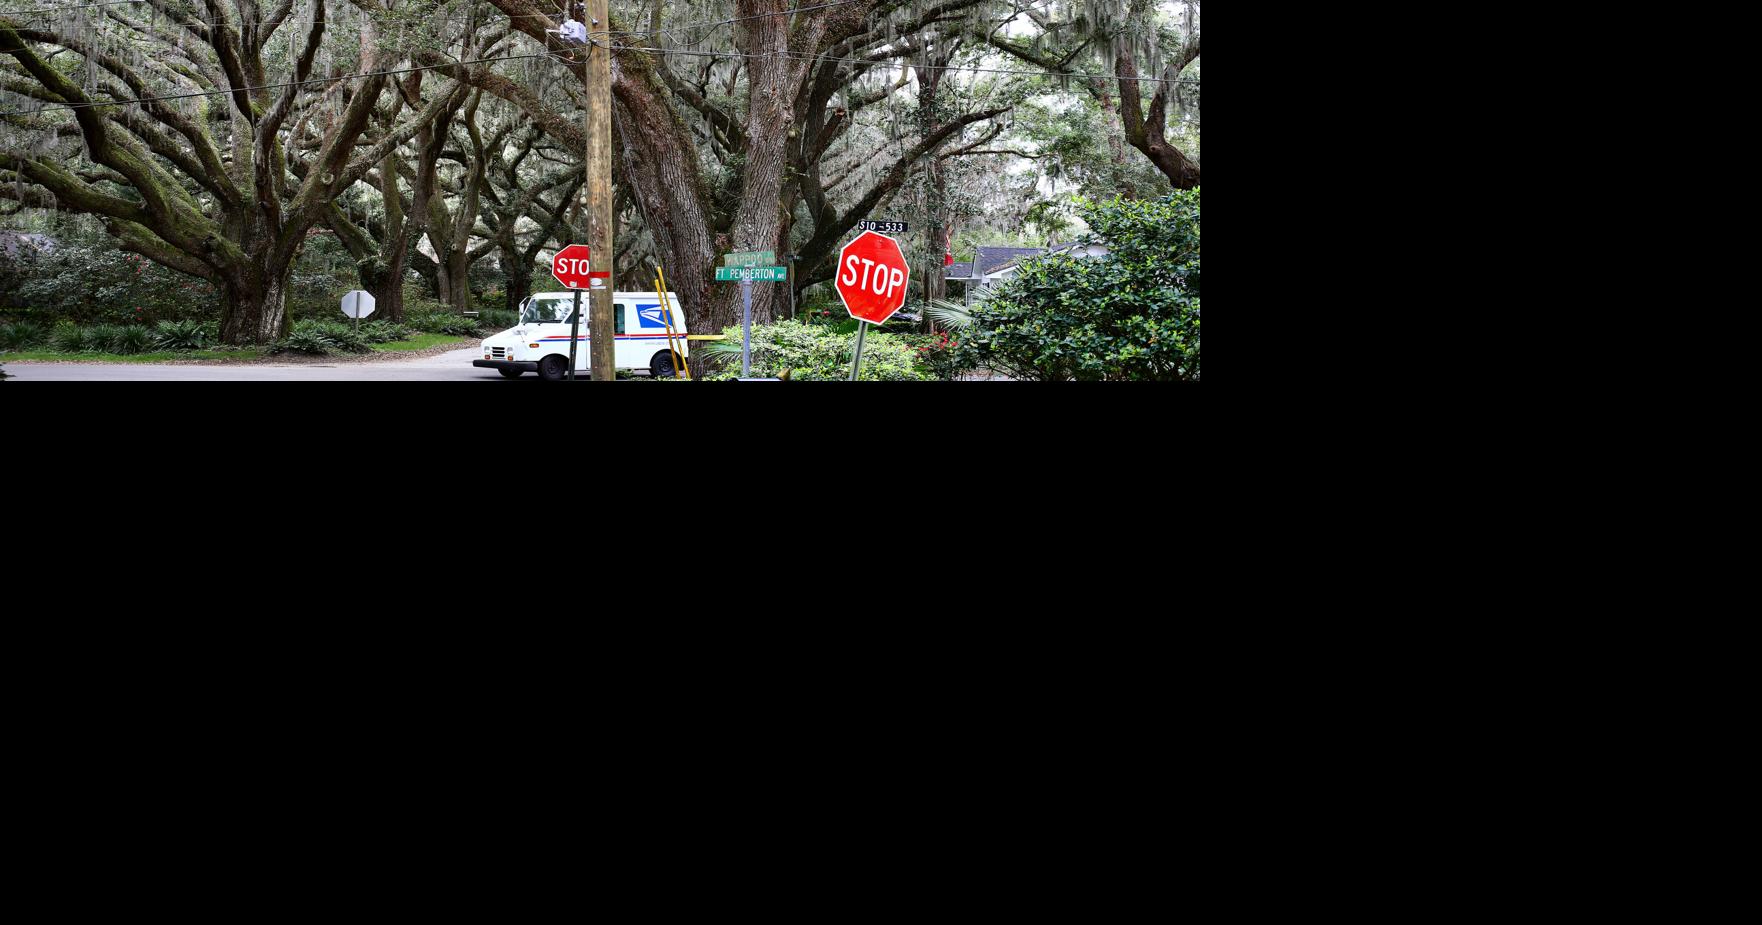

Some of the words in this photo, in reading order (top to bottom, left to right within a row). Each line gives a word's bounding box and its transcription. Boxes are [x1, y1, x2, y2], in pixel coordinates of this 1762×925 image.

[556, 257, 590, 276] STO
[716, 269, 724, 279] FT
[730, 269, 775, 279] PEMBERTON
[842, 254, 904, 298] STOP
